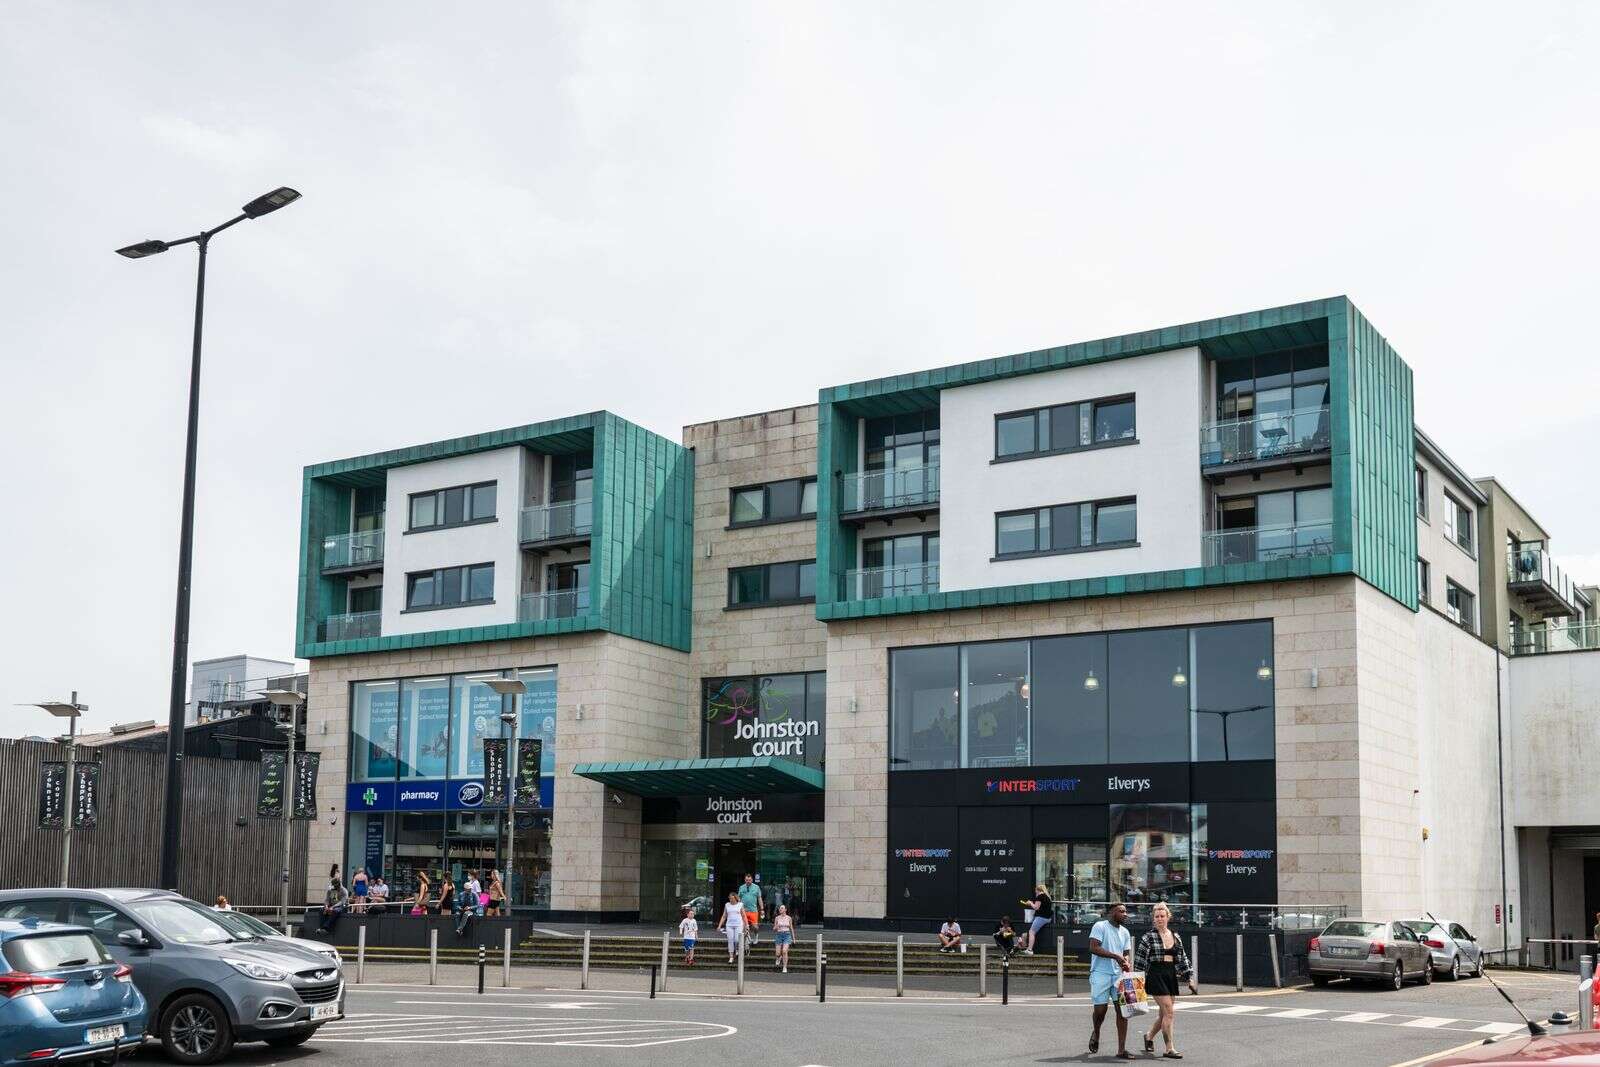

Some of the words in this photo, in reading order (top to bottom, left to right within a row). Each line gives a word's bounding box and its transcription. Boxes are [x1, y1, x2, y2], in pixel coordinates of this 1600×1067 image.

[734, 717, 818, 740] Johnston
[752, 737, 803, 757] court
[998, 779, 1077, 792] INTERSPORT
[1108, 776, 1151, 792] Elverys
[401, 789, 440, 802] pharmacy
[461, 786, 480, 801] Boots
[706, 796, 763, 811] Johnston
[716, 811, 752, 824] court
[902, 848, 951, 858] INTERSPORT
[1216, 849, 1273, 859] INTERSPORT
[910, 863, 937, 874] Elverys
[1226, 864, 1257, 876] Elverys
